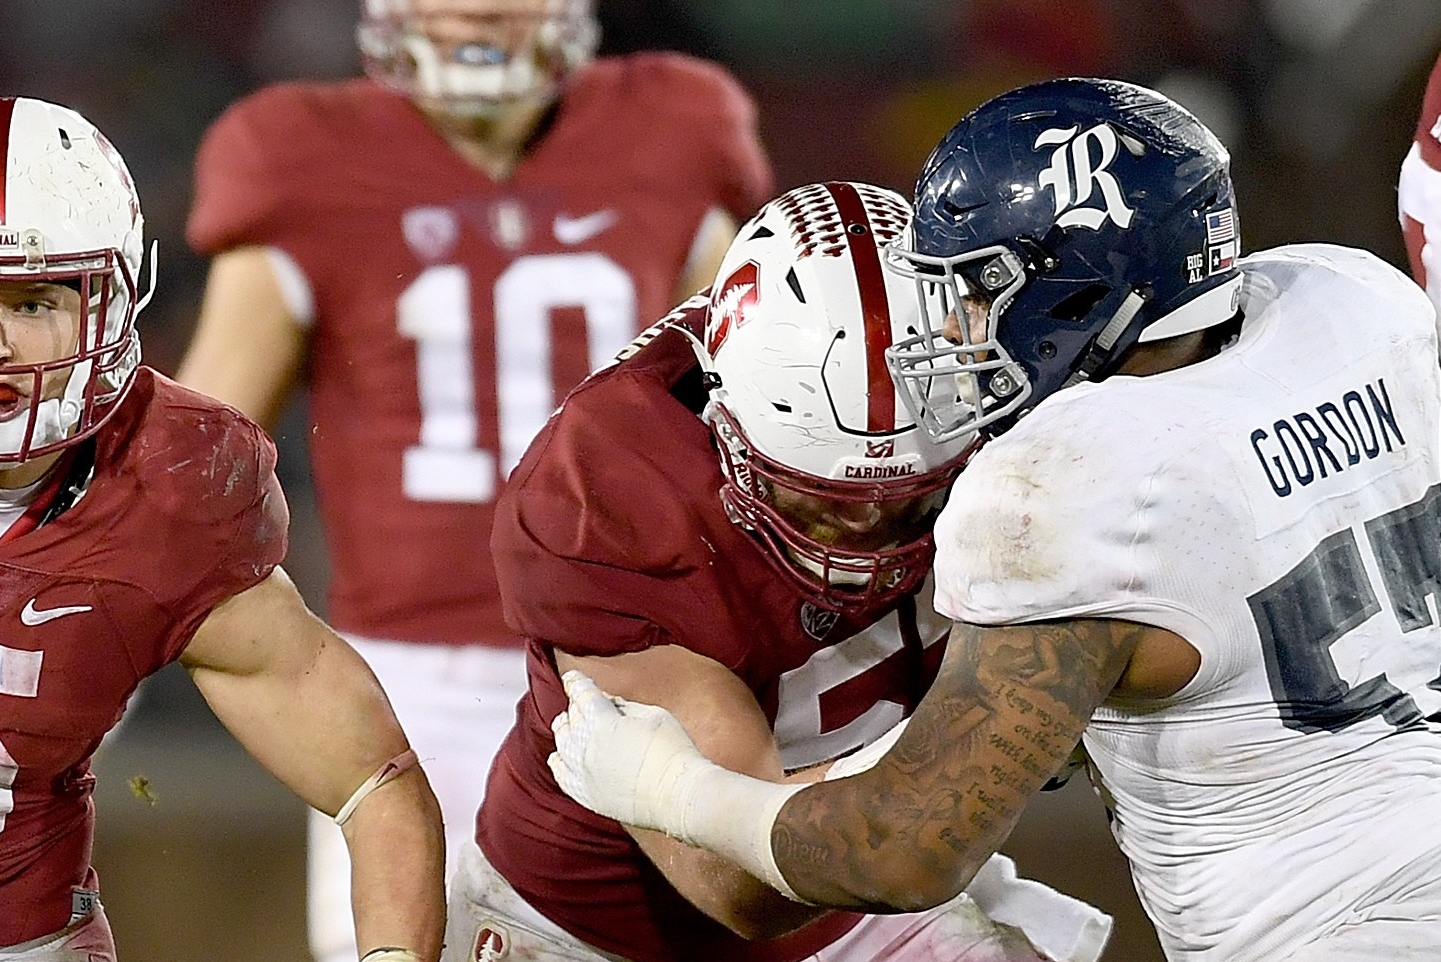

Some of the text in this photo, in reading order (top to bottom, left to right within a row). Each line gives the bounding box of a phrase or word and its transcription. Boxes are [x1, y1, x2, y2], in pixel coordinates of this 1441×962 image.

[1034, 123, 1135, 231] R
[1187, 253, 1203, 271] BIG
[1189, 268, 1203, 284] AL
[395, 252, 639, 504] 10
[1250, 378, 1406, 498] GORDON
[845, 461, 916, 479] CARDINAL
[80, 897, 92, 911] 38
